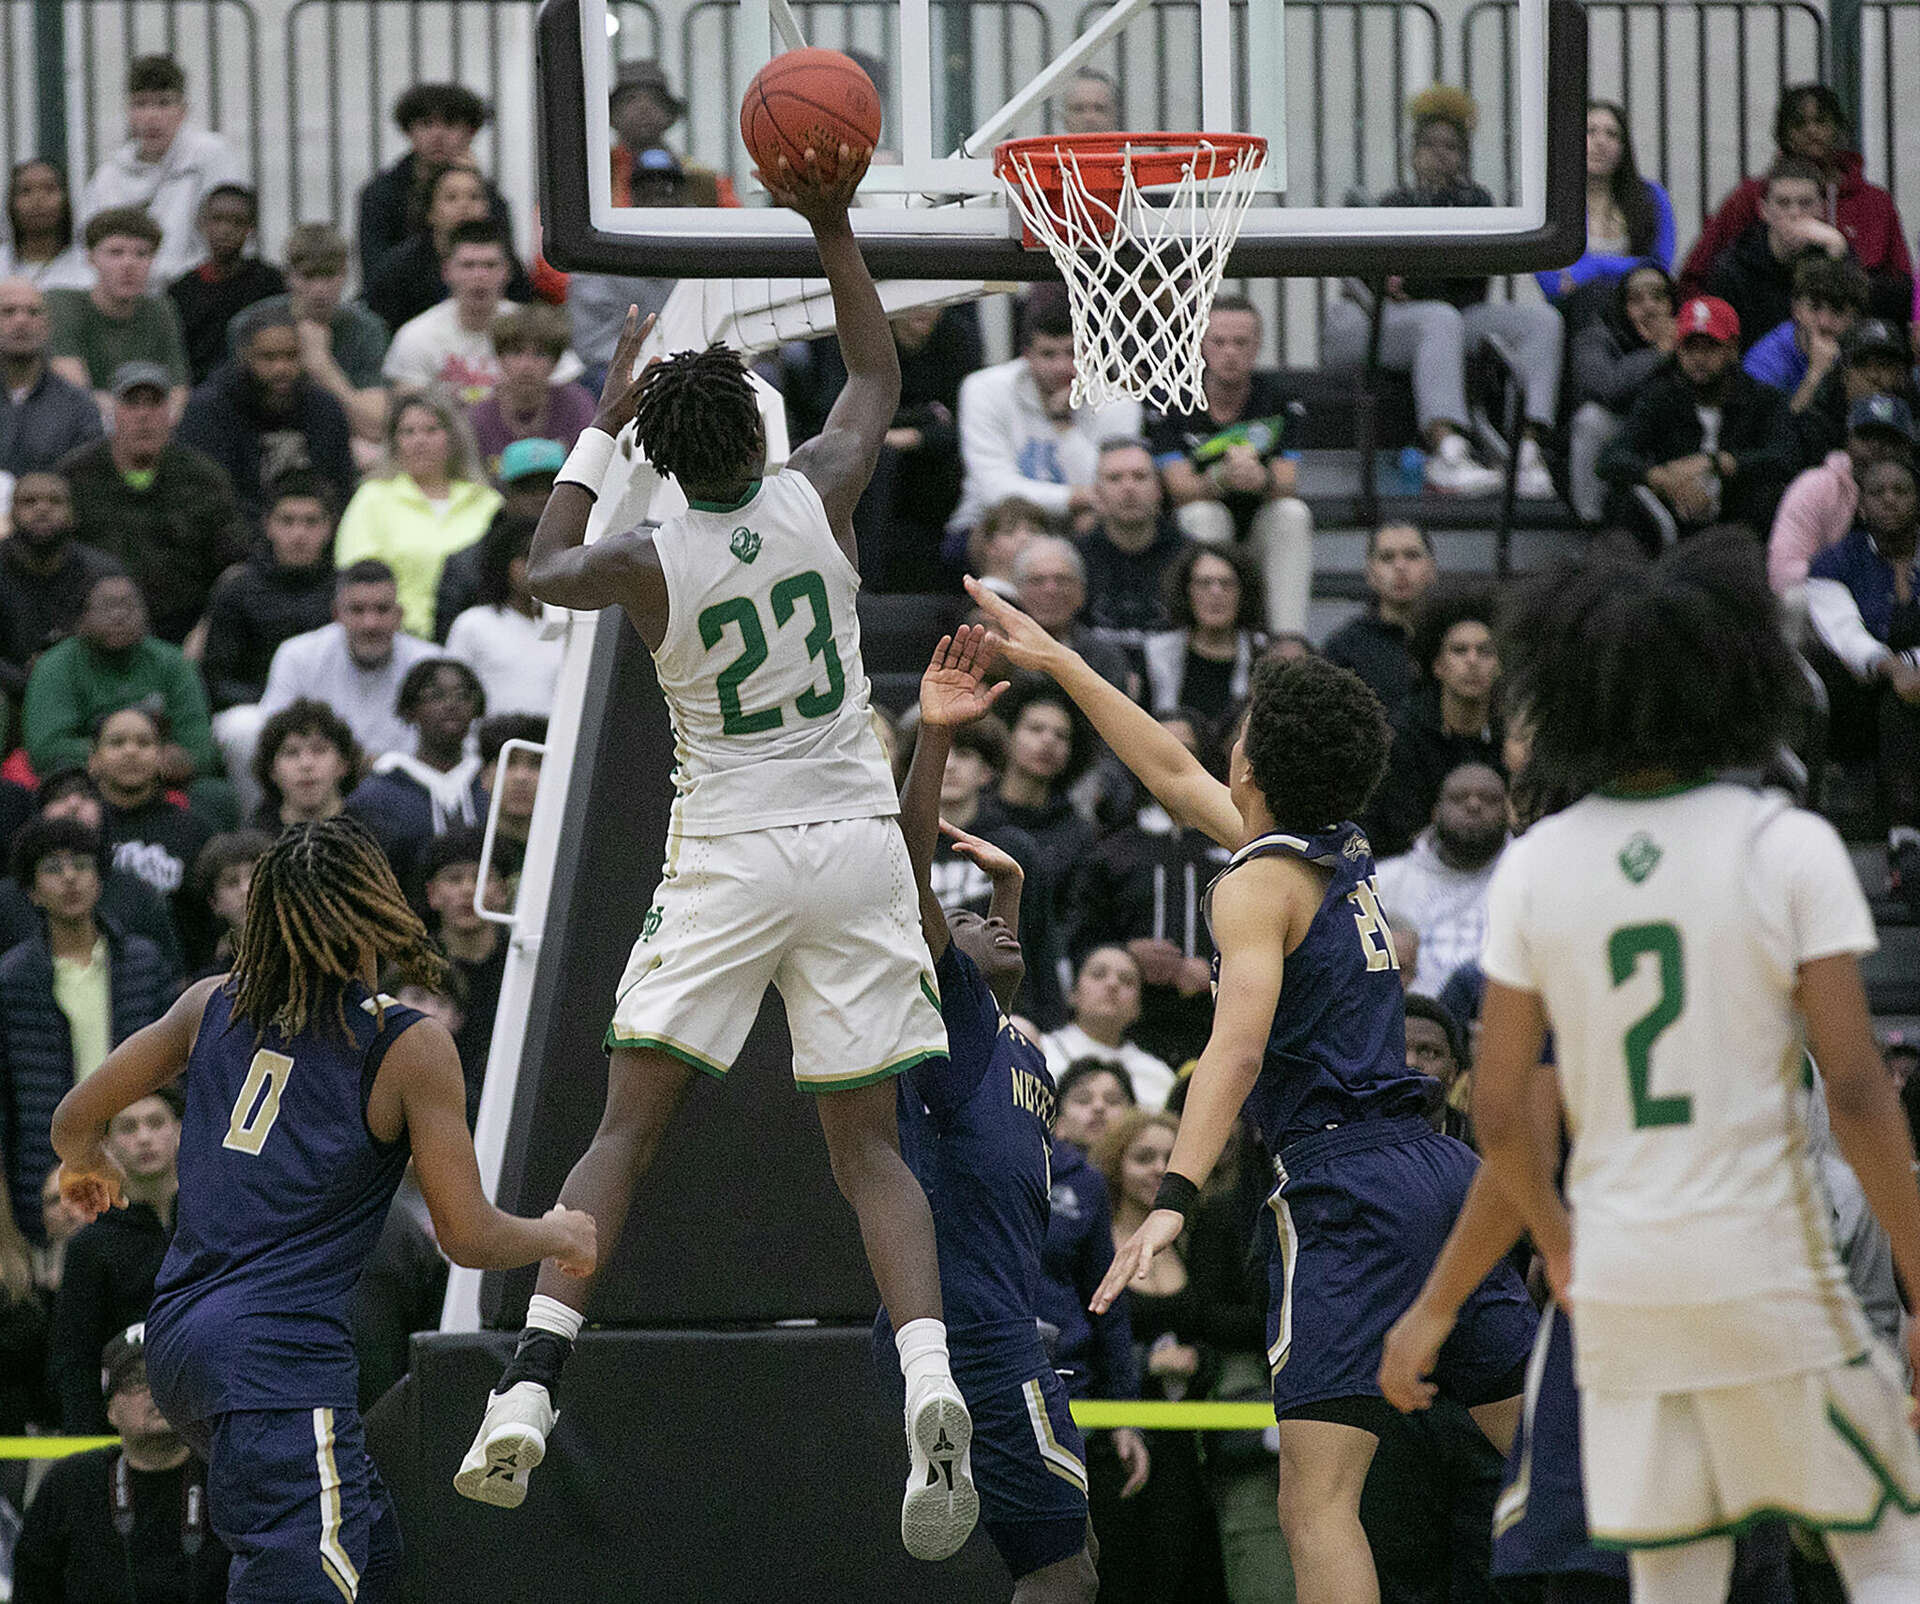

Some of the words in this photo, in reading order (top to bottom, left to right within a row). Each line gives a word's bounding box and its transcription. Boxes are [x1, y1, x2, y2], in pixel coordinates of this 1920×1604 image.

[698, 570, 846, 736] 23
[222, 1047, 295, 1156] 0
[1607, 920, 1693, 1130] 2
